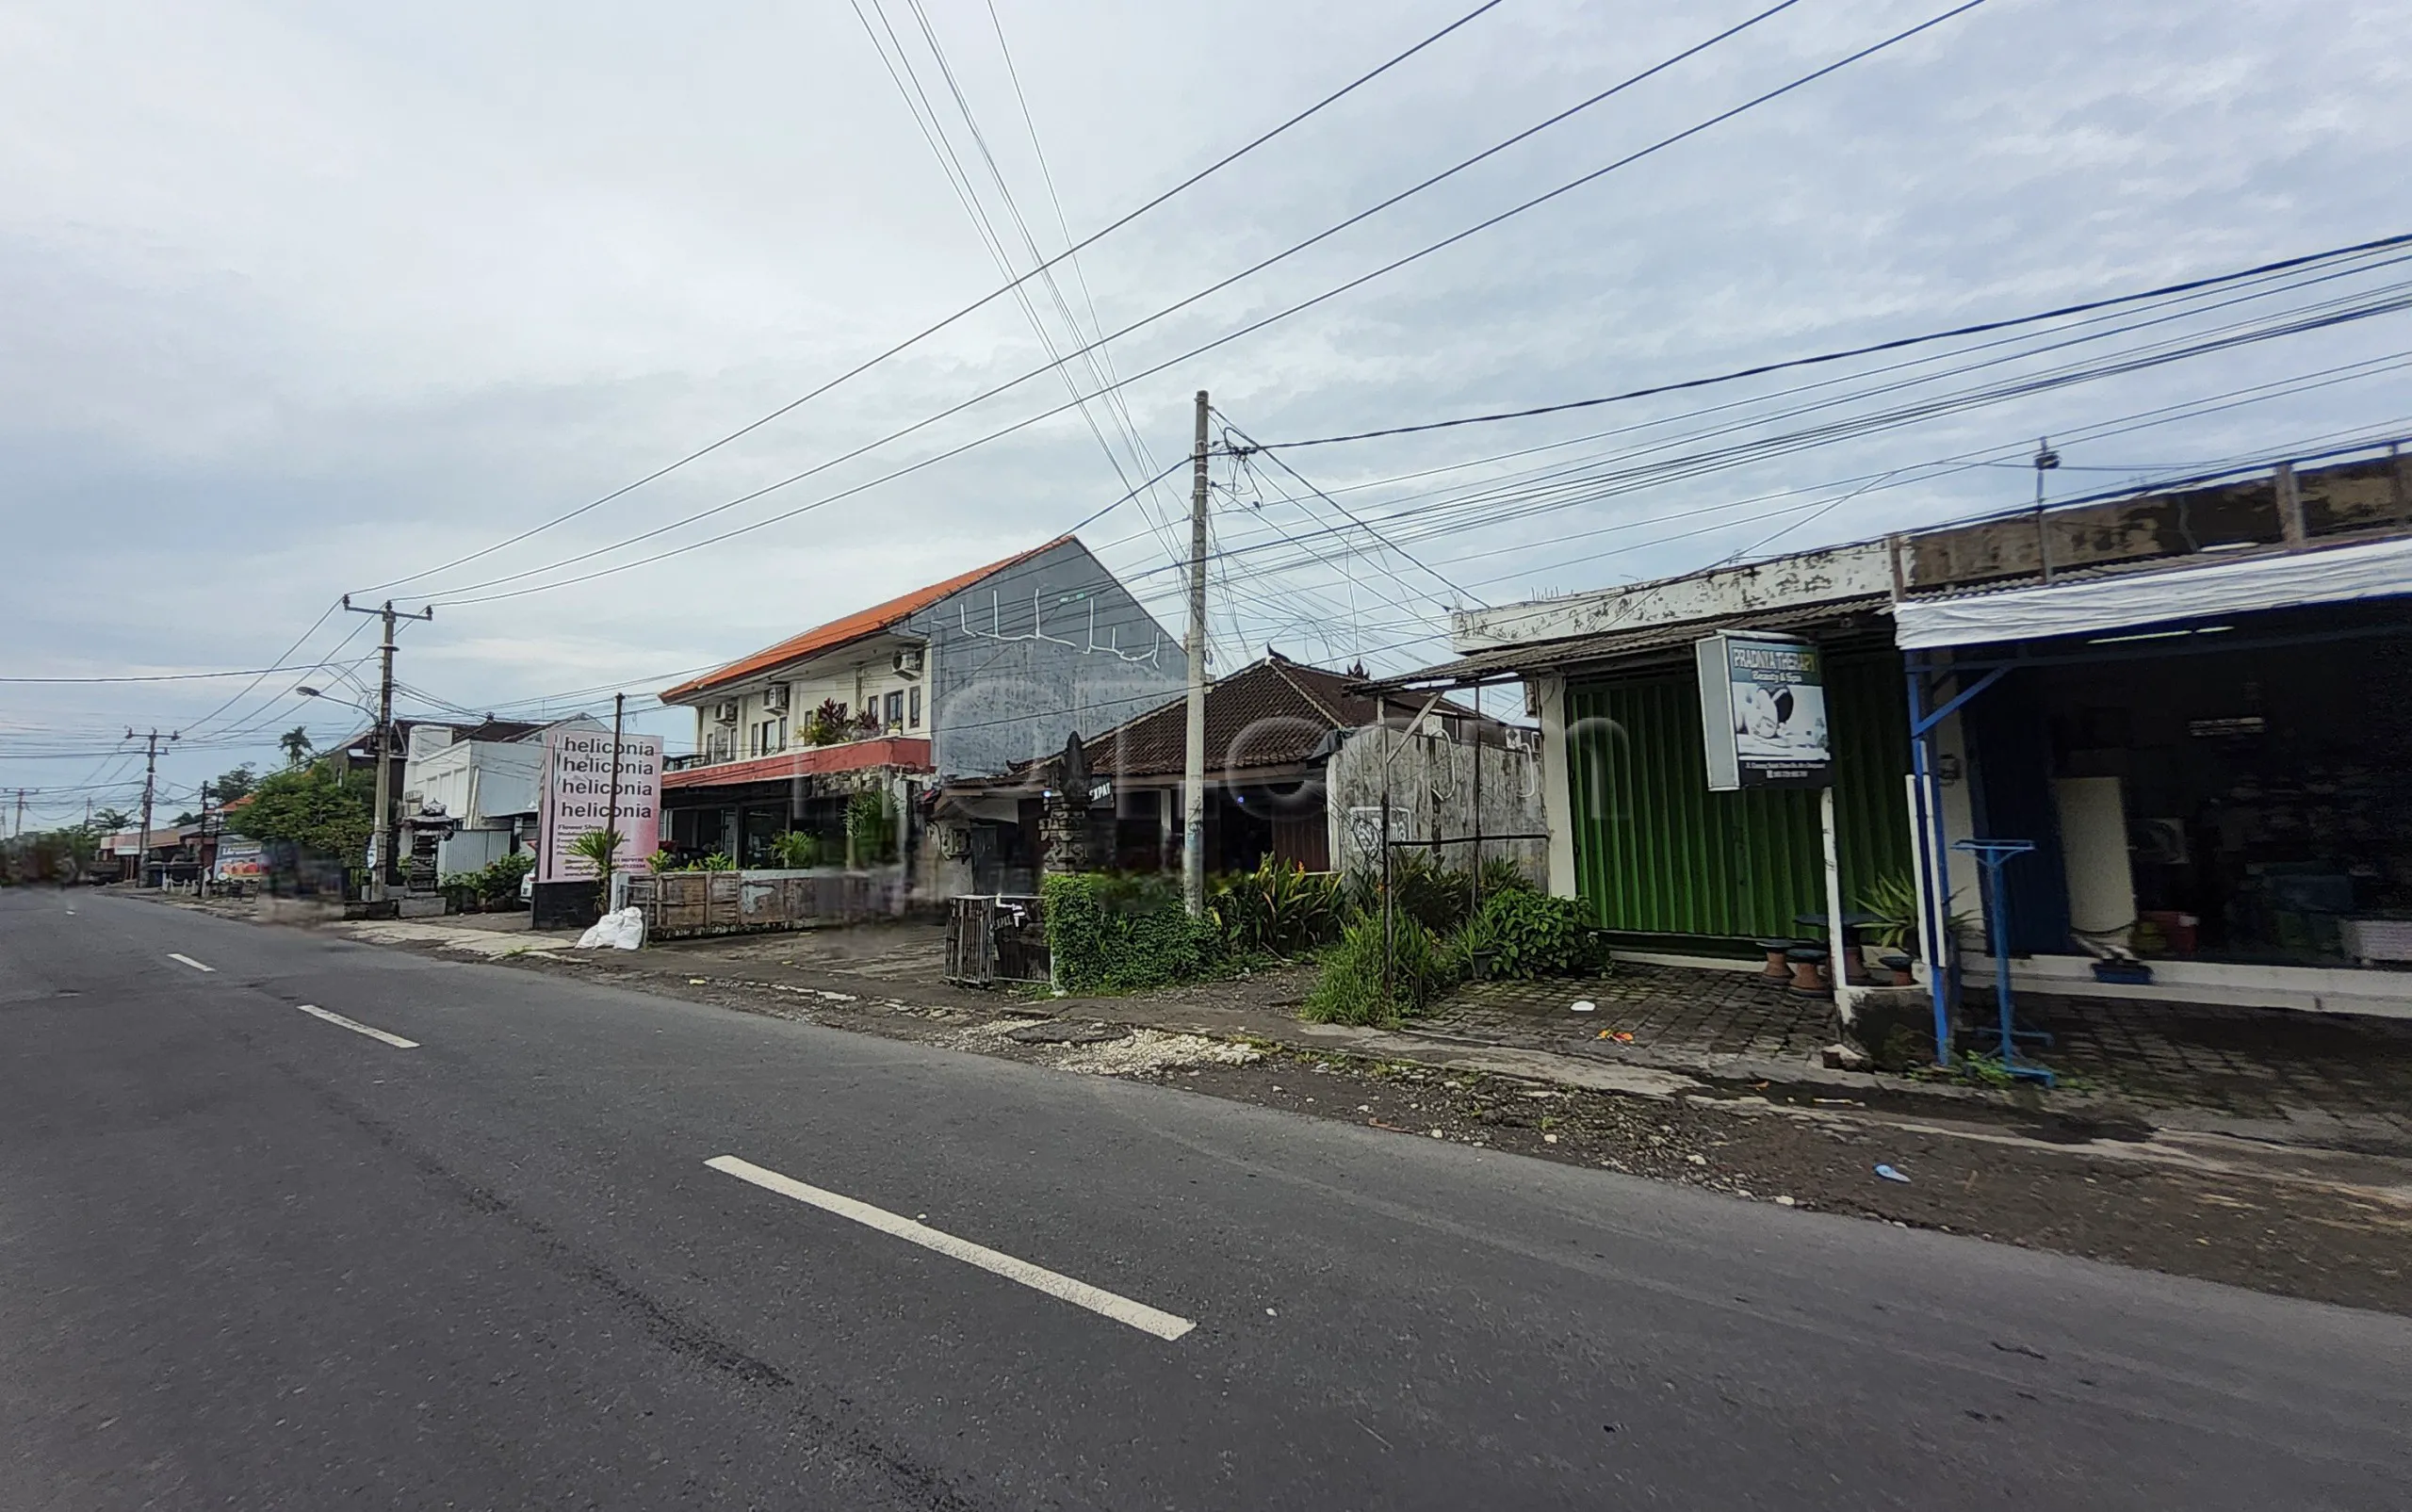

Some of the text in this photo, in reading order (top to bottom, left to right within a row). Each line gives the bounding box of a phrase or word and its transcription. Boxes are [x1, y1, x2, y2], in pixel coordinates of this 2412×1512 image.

[1779, 672, 1786, 681] &
[564, 737, 655, 756] heliconia
[563, 756, 654, 774] heliconia
[562, 779, 653, 796] heliconia
[562, 802, 652, 819] heliconia
